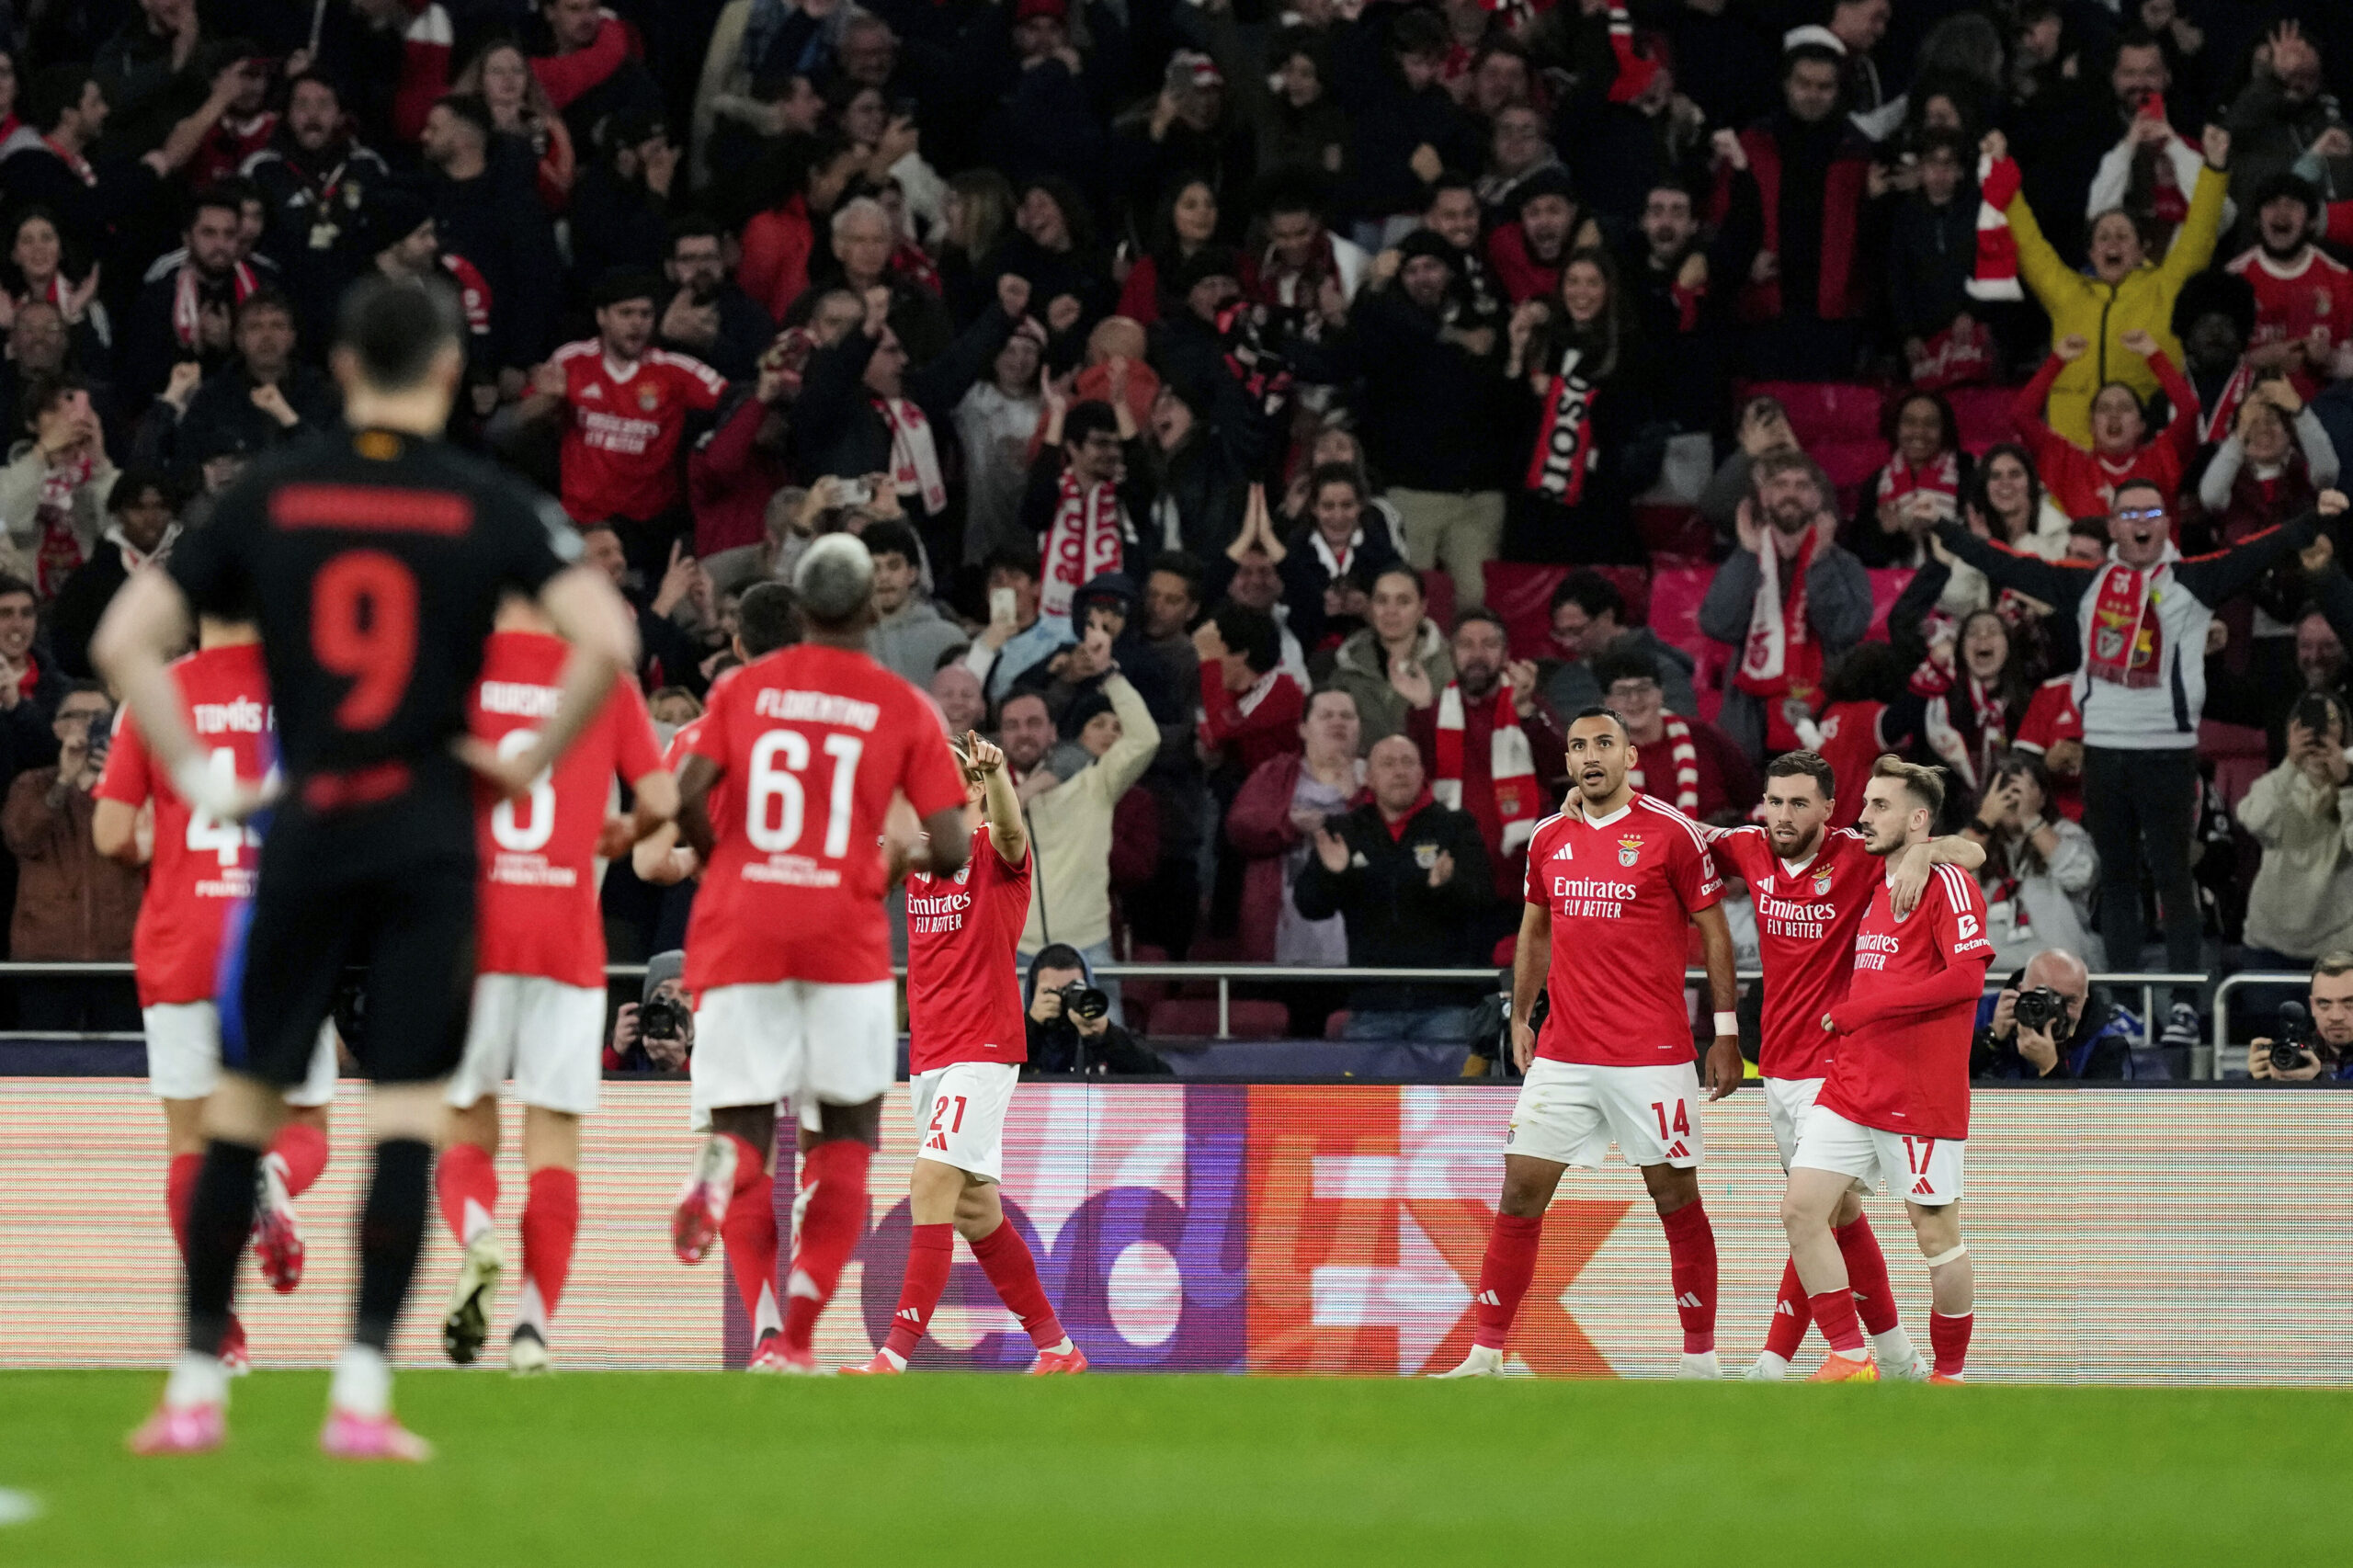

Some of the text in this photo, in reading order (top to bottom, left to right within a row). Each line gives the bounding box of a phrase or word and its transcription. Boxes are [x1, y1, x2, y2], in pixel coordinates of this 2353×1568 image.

[310, 549, 419, 732] 9
[745, 728, 864, 858] 61
[1554, 876, 1636, 901] Emirates
[908, 891, 971, 915] Emirates
[1564, 899, 1622, 918] FLY BETTER
[1758, 893, 1836, 920] Emirates
[915, 914, 962, 933] FLY BETTER
[1767, 919, 1823, 939] FLY BETTER
[929, 1096, 968, 1133] 21
[1652, 1098, 1690, 1140] 14
[1902, 1136, 1935, 1175] 17
